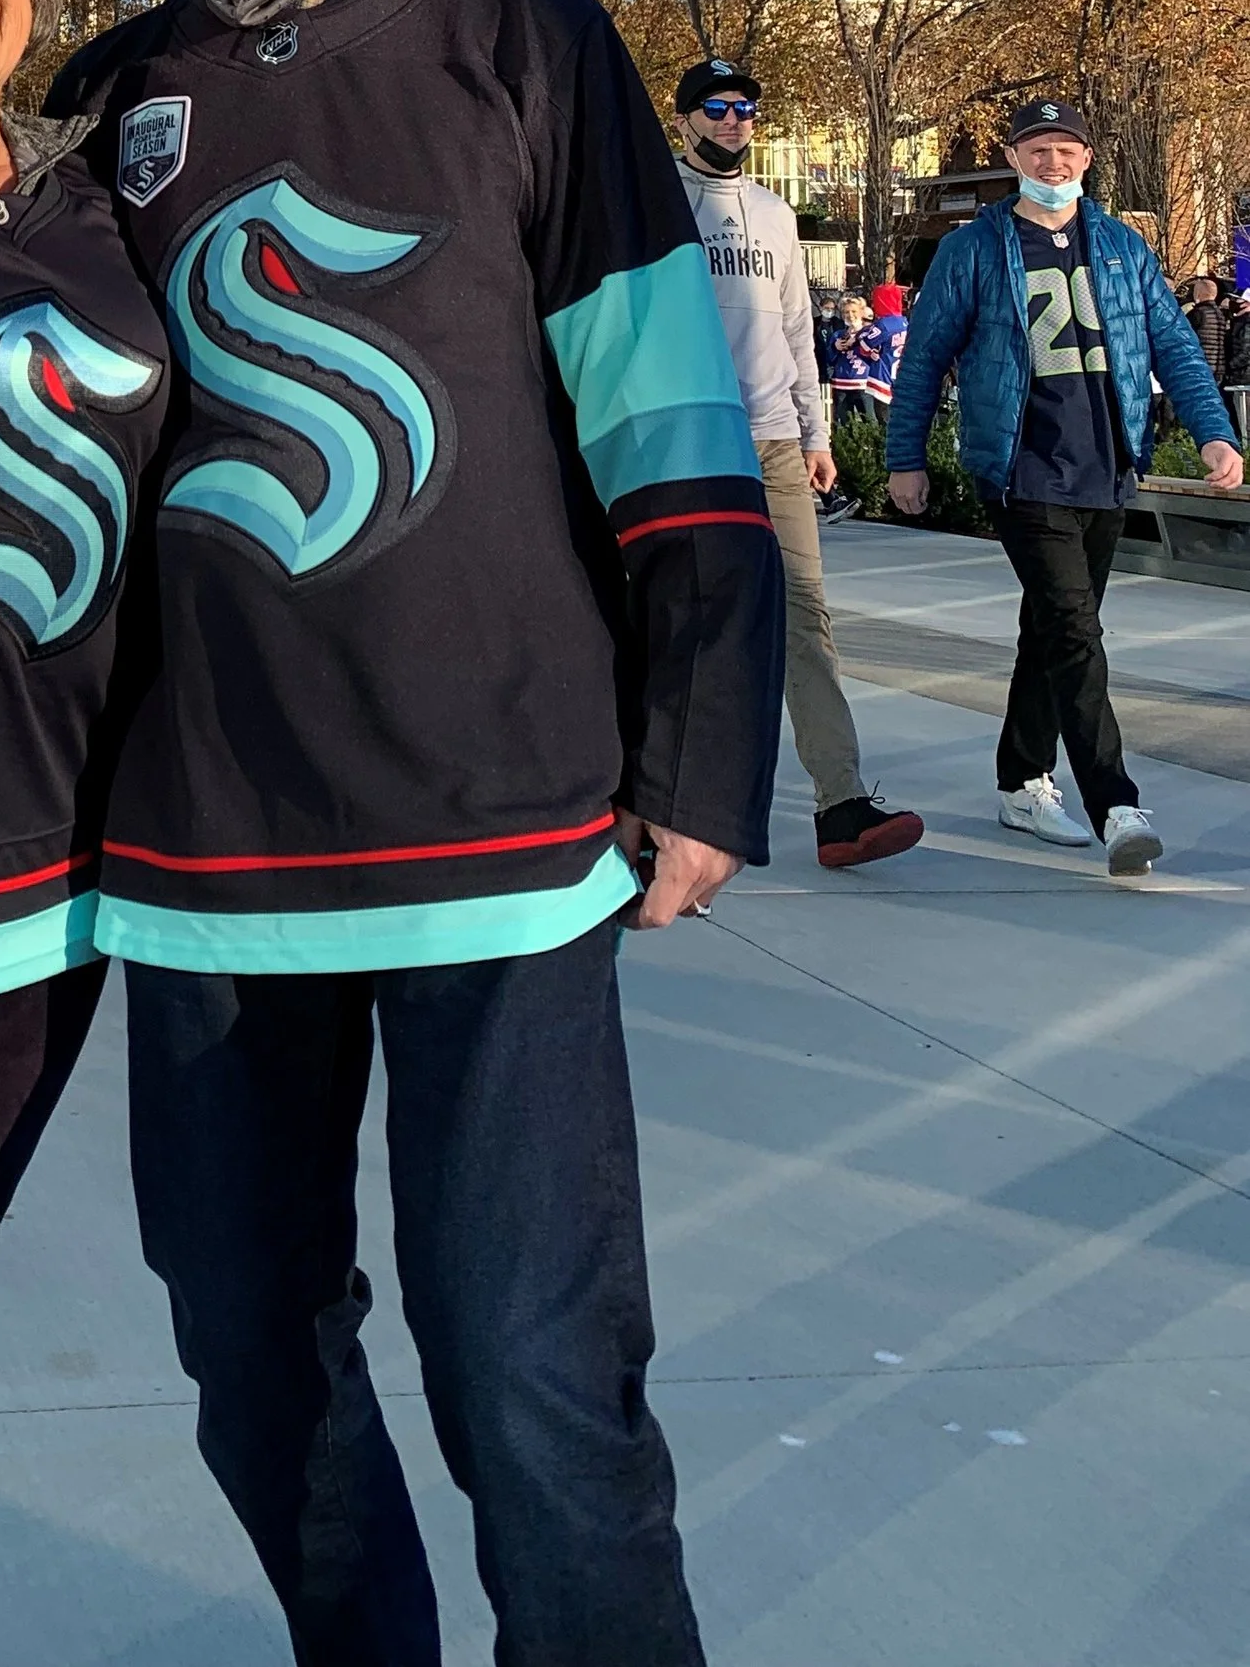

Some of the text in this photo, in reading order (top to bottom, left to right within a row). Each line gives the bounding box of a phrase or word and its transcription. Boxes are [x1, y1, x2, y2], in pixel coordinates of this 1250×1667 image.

[265, 32, 290, 53] NHL
[127, 114, 175, 142] INAUGURAL
[132, 137, 166, 158] SEASON
[704, 233, 761, 247] SEATTE
[707, 246, 775, 280] RAKEN
